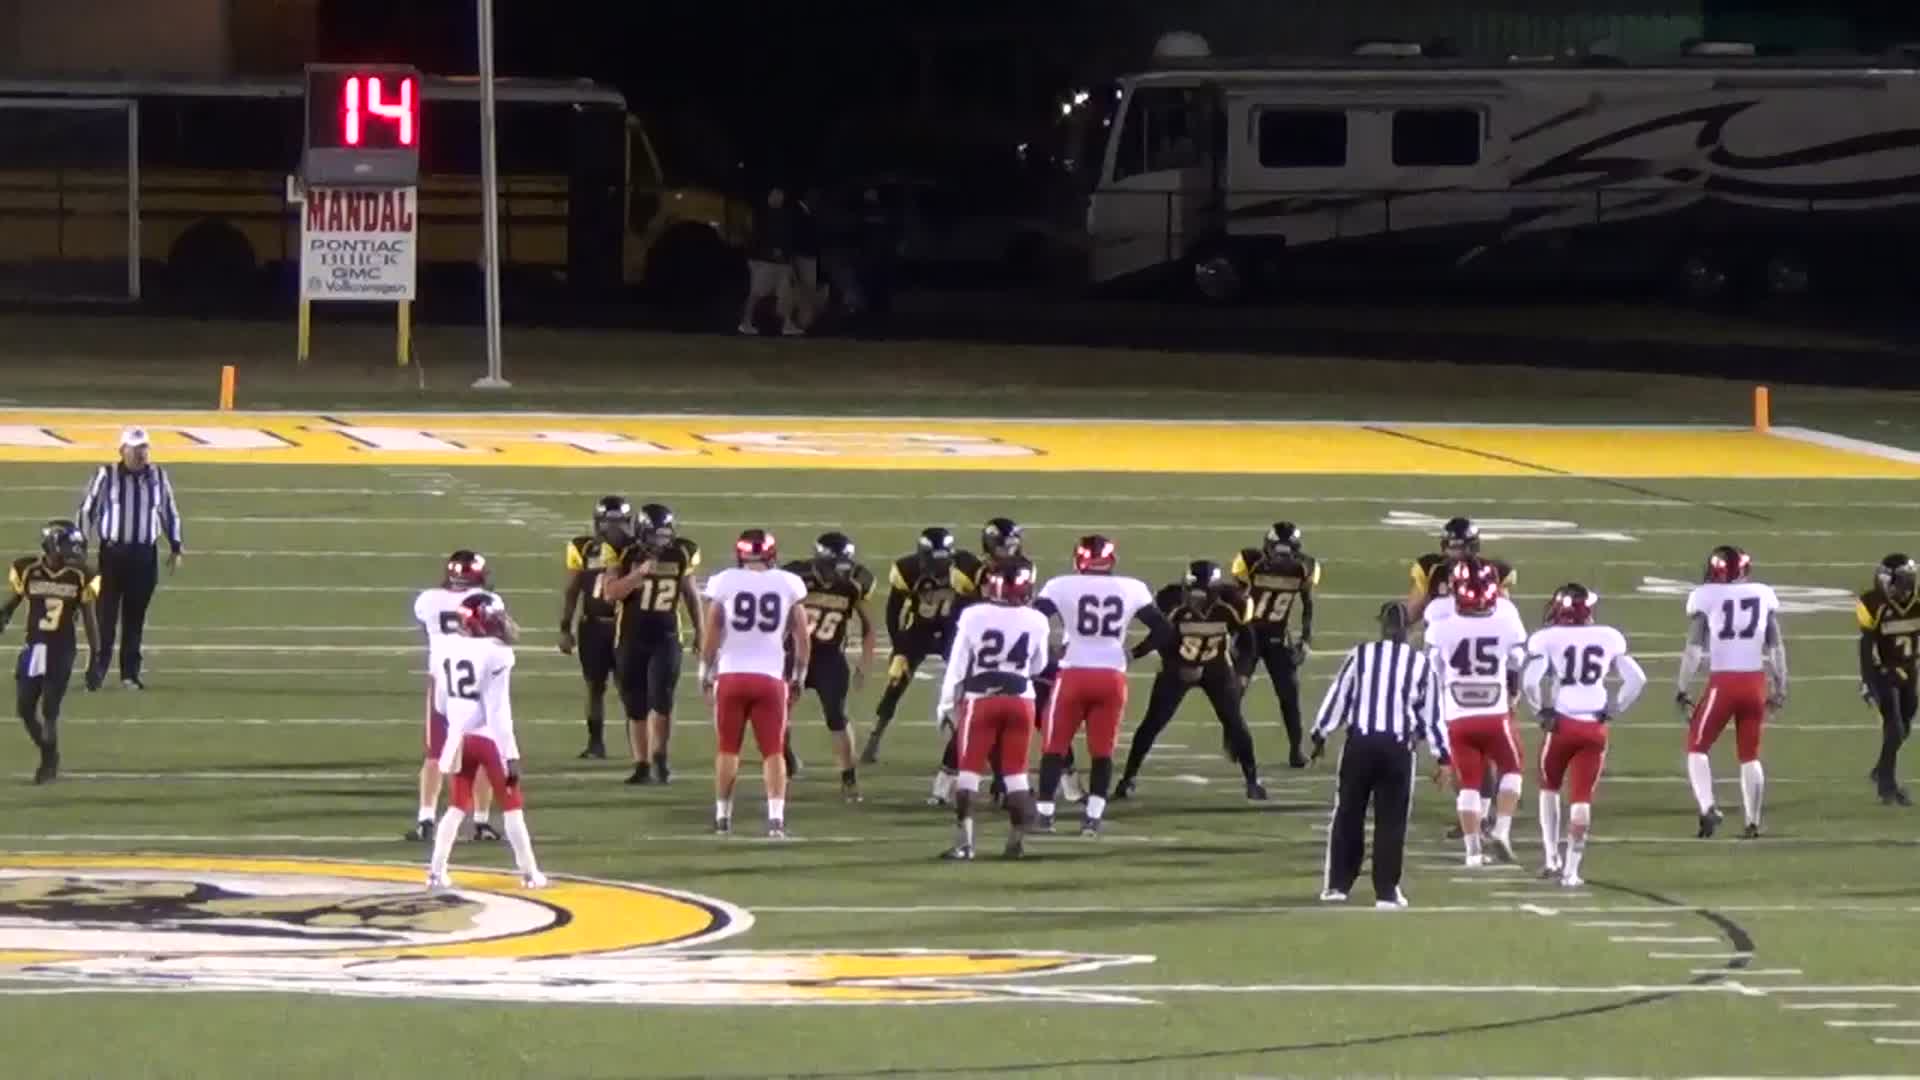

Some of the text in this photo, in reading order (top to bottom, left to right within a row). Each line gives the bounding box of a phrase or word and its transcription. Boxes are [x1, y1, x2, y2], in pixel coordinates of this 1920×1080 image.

[346, 77, 412, 144] 14
[306, 190, 413, 232] MANDAL
[311, 239, 407, 252] PONTIAC
[332, 267, 381, 280] GMC
[36, 598, 64, 631] 3
[641, 578, 677, 610] 12
[732, 591, 781, 632] 99
[1077, 594, 1124, 637] 62
[1718, 597, 1761, 639] 17
[977, 629, 1029, 669] 24
[1450, 637, 1499, 676] 45
[1561, 645, 1604, 686] 16
[443, 657, 481, 701] 12
